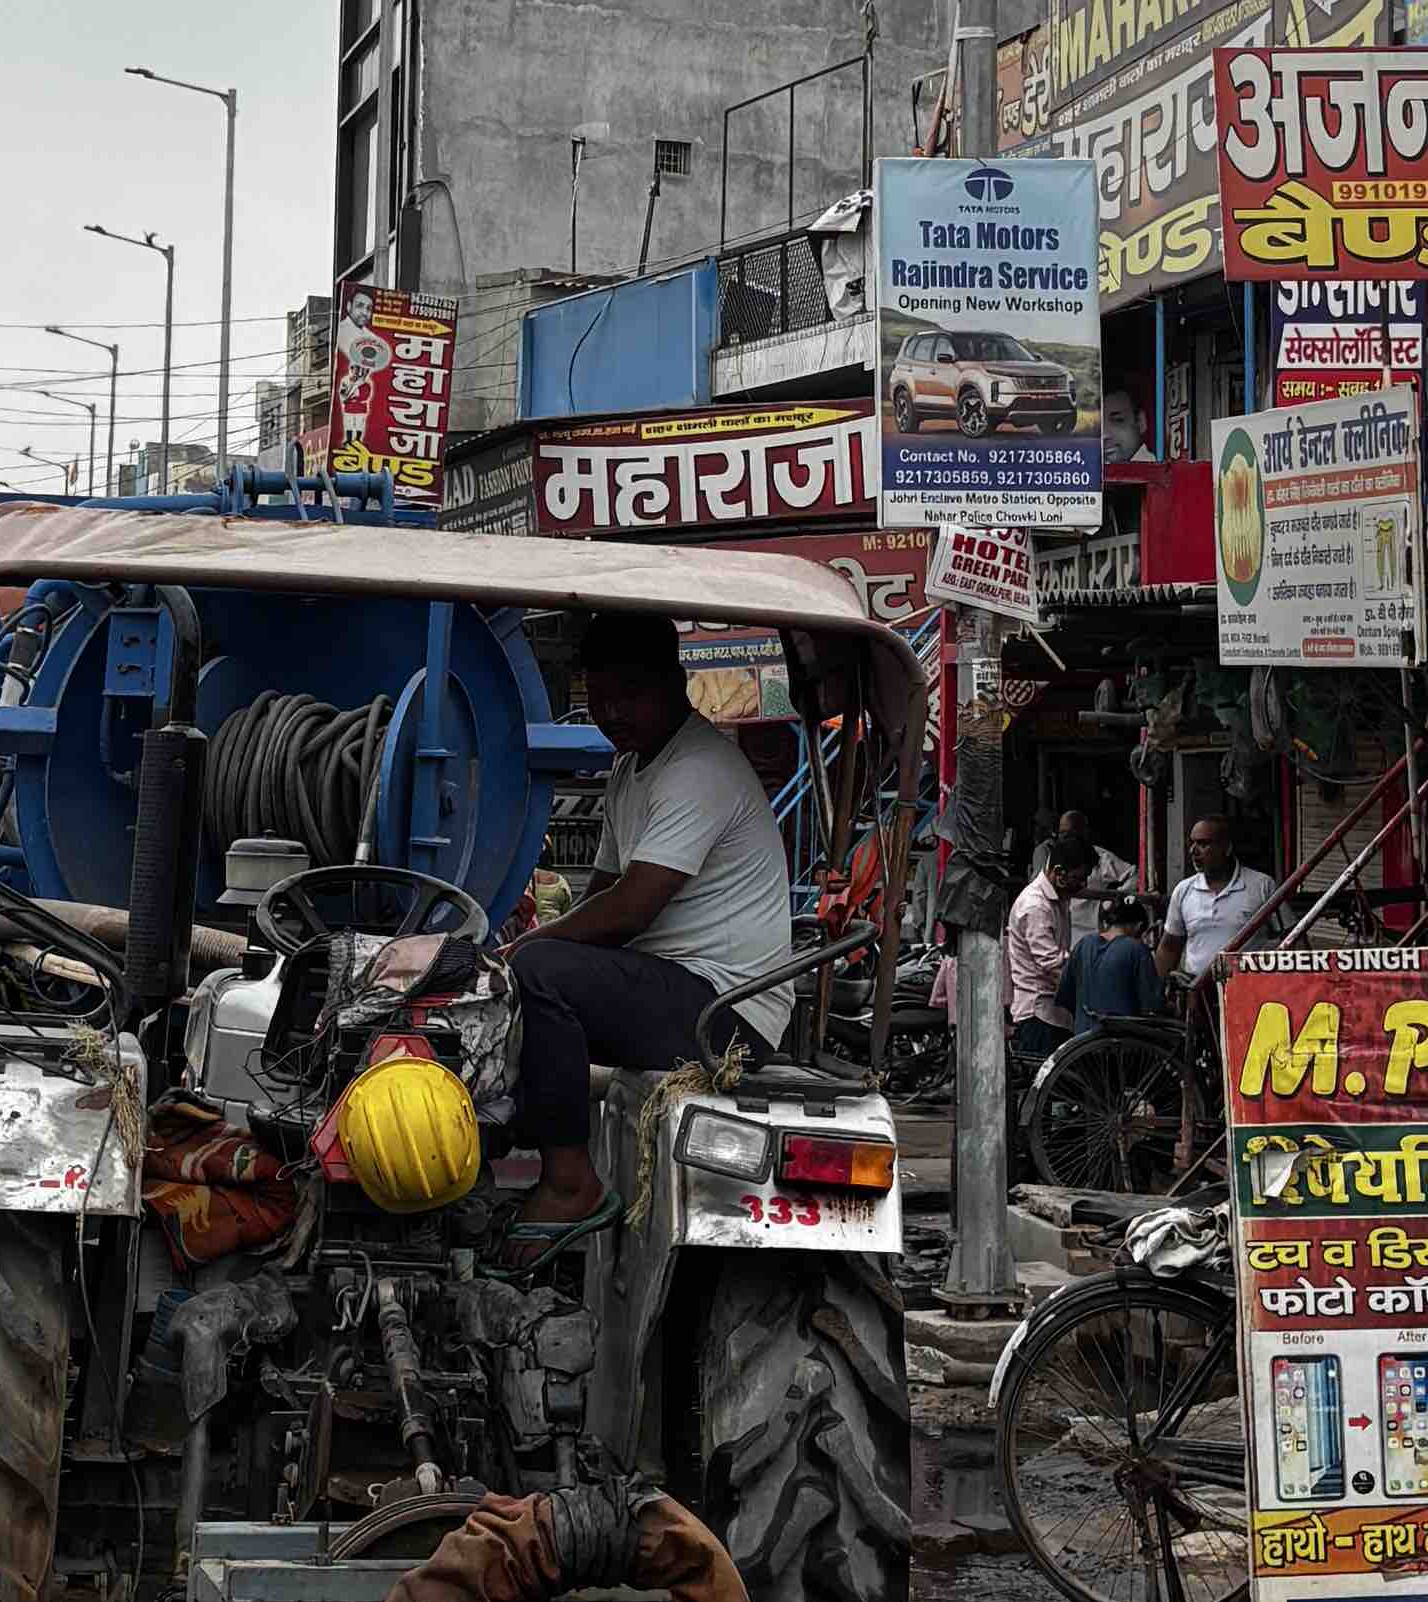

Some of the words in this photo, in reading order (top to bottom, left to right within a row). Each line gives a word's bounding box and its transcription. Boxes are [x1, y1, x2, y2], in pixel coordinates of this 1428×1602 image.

[959, 205, 984, 214] TATA
[986, 205, 1021, 215] MOTORS
[920, 221, 972, 249] Tata
[976, 220, 1059, 250] Motors
[892, 259, 992, 290] Rajindra
[998, 261, 1088, 290] Service
[899, 294, 961, 312] Opening
[966, 295, 1001, 311] New
[1006, 297, 1083, 315] Workshop
[899, 449, 954, 463] Contact
[958, 449, 980, 464] No.
[989, 450, 1085, 465] 9217305864,
[539, 414, 878, 527] महाराजा
[895, 470, 992, 485] 9217305859,
[997, 471, 1090, 486] 9217305860
[890, 492, 918, 504] John
[921, 493, 963, 504] Enclave
[966, 493, 999, 504] Metro
[1047, 494, 1097, 507] Opposite
[924, 511, 957, 522] Nahar
[960, 511, 993, 523] Police
[996, 511, 1037, 523] Chowki
[1040, 512, 1063, 522] Loni
[864, 536, 882, 550] M:
[952, 554, 1001, 581] GREEN
[1335, 949, 1421, 971] SINGH
[1246, 1240, 1312, 1271] टच
[1322, 1239, 1357, 1269] व
[1260, 1275, 1356, 1318] फोटो
[1282, 1333, 1325, 1345] Before
[1397, 1331, 1428, 1344] After
[1362, 1521, 1419, 1564] हाथ
